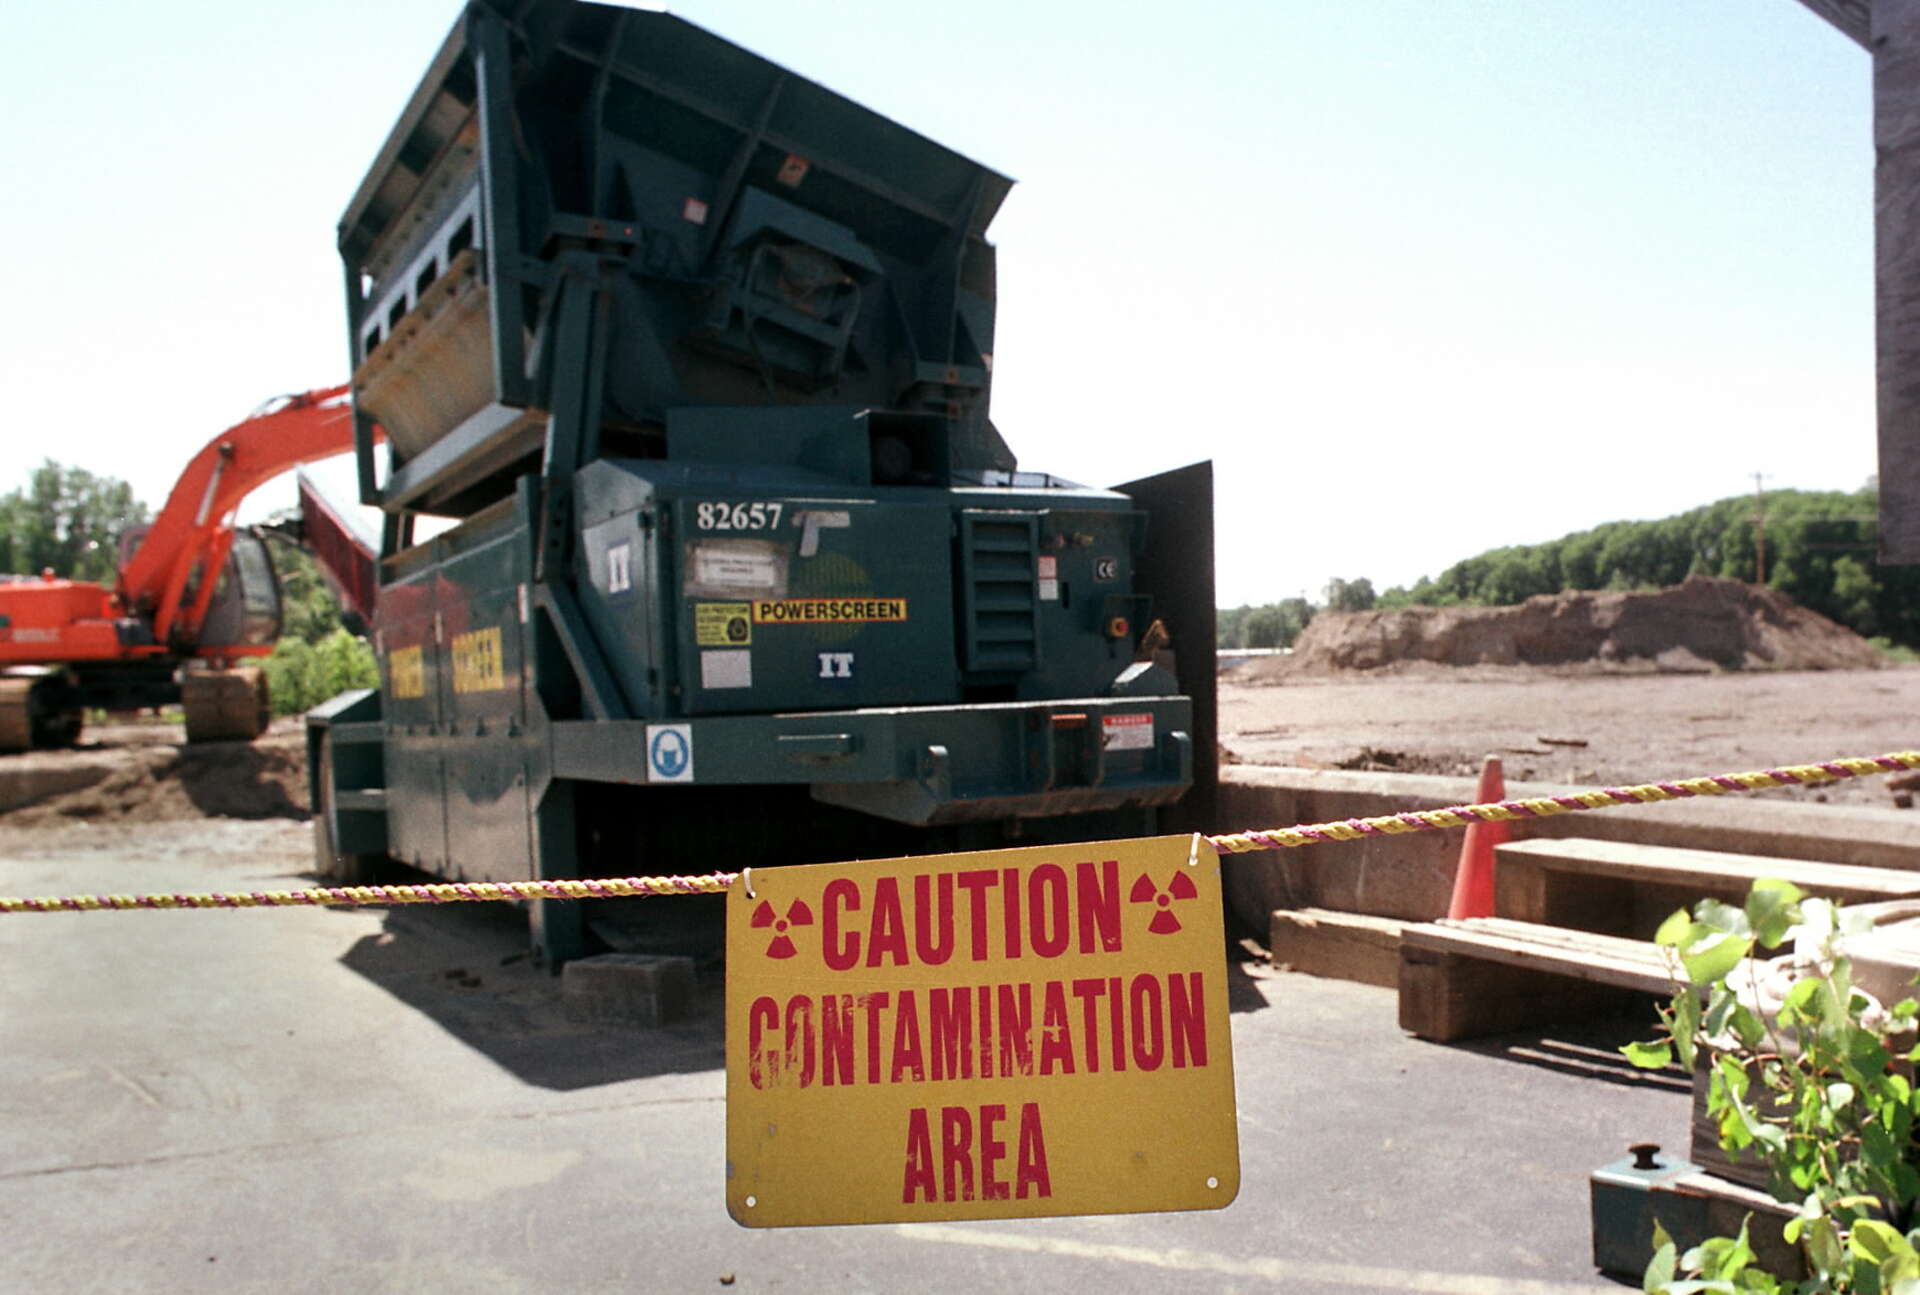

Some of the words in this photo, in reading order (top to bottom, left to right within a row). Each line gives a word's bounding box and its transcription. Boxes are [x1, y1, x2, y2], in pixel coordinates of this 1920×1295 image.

[697, 502, 782, 530] 82657
[760, 601, 901, 620] POWERSCREEN
[821, 860, 1123, 971] CAUTION
[748, 971, 1208, 1091] CONTAMINATION
[901, 1101, 1052, 1204] AREA
